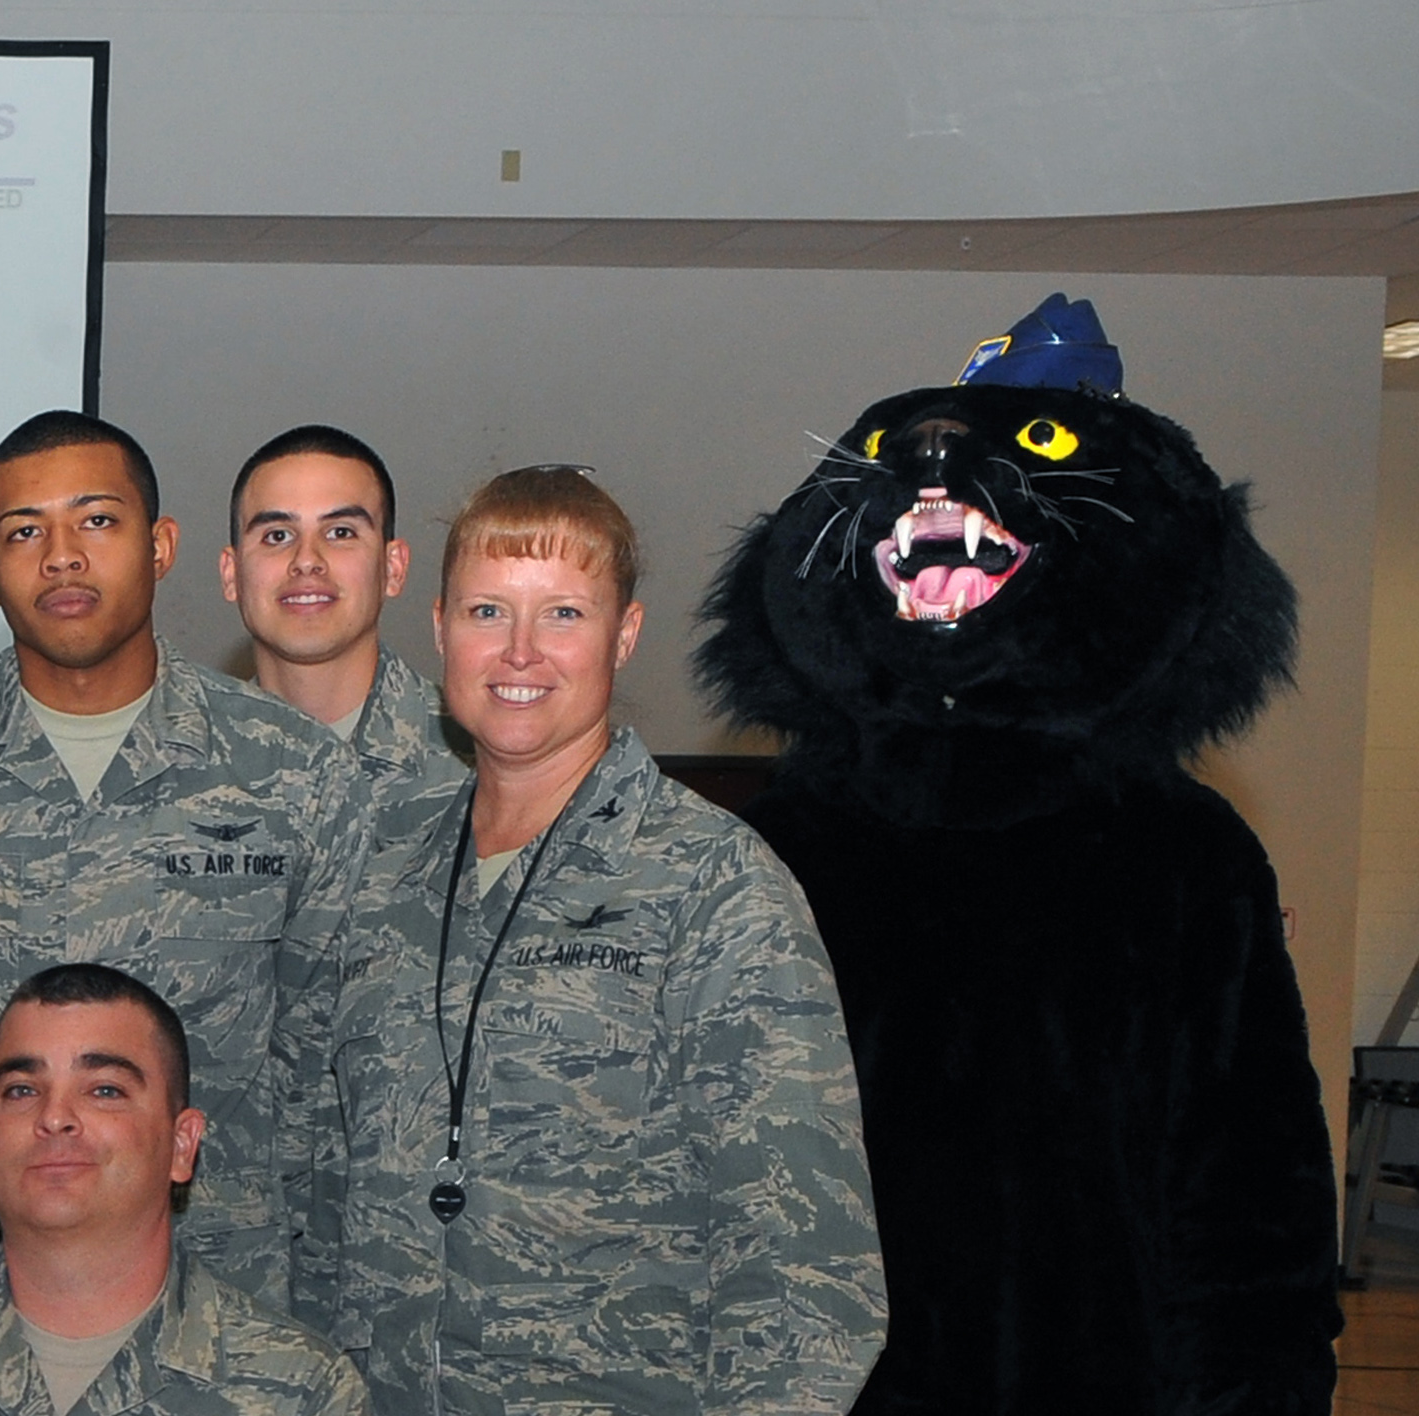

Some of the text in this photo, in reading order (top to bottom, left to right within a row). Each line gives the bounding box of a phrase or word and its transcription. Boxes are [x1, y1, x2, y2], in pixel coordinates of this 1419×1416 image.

[166, 854, 285, 876] U.S. AIR FORCE
[551, 943, 583, 967] AIR
[588, 943, 647, 977] FORCE
